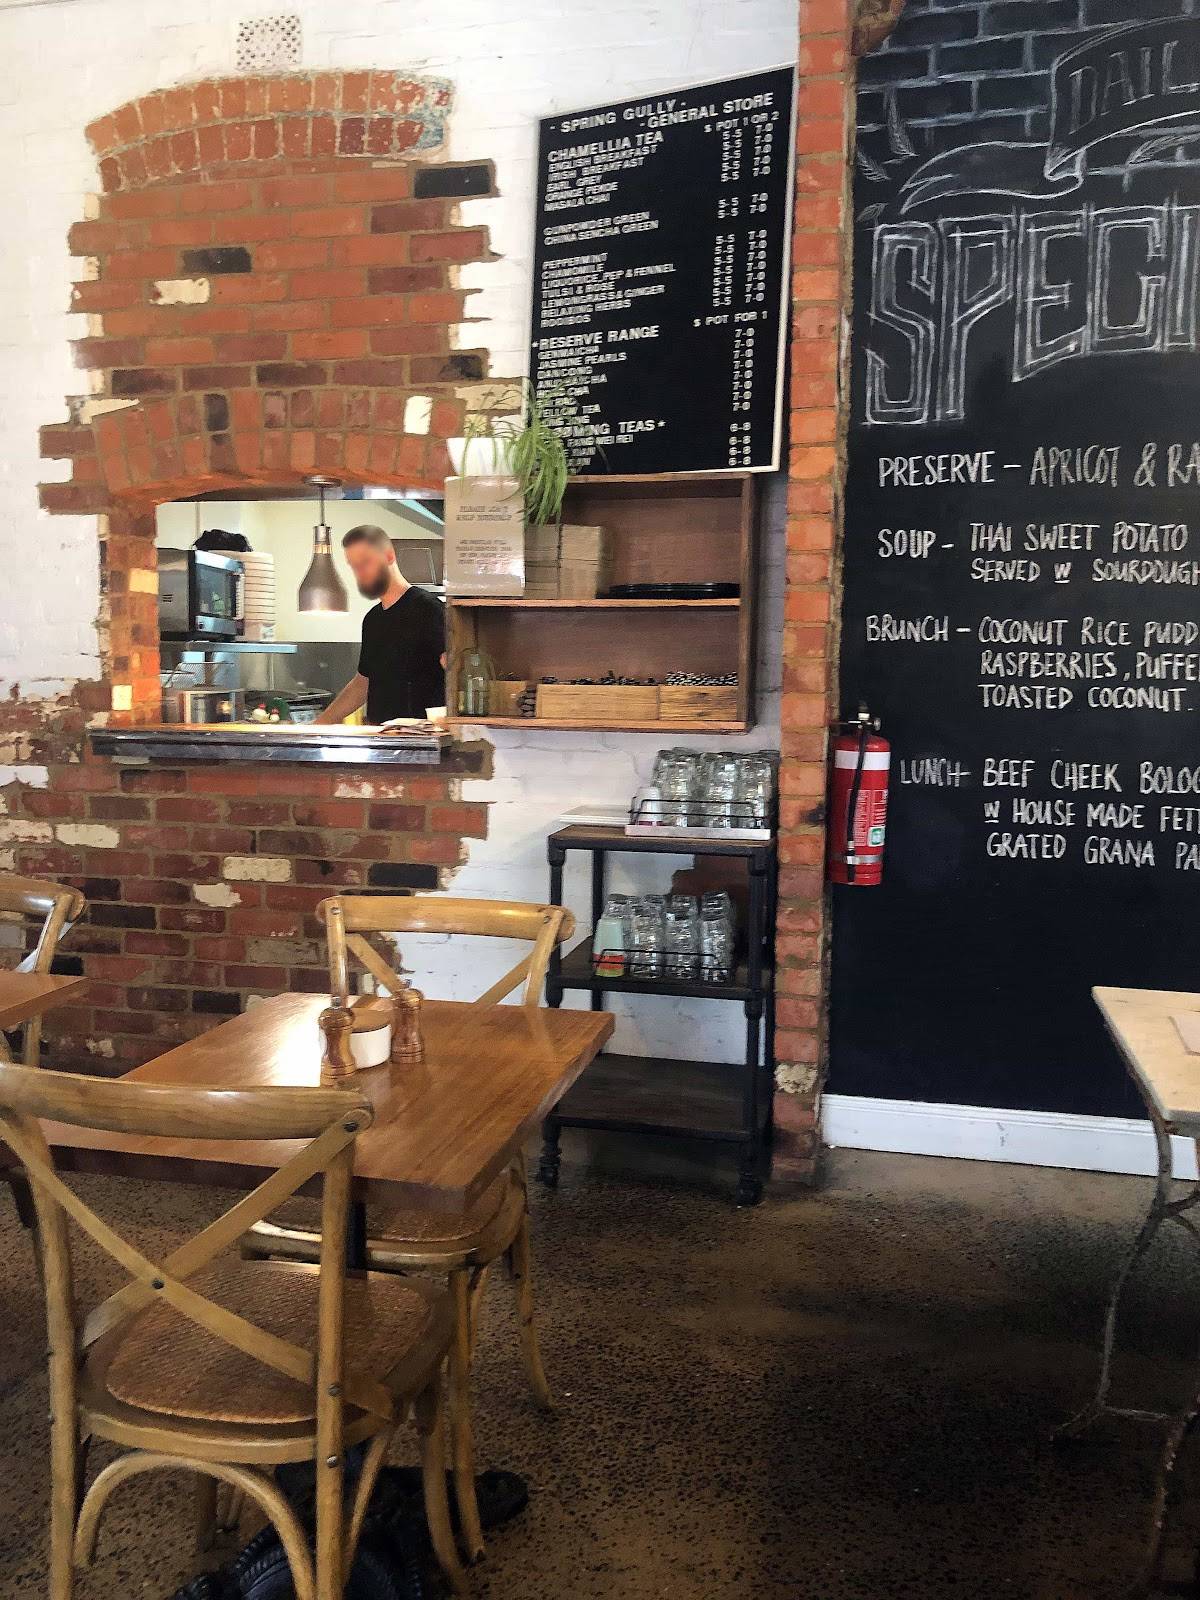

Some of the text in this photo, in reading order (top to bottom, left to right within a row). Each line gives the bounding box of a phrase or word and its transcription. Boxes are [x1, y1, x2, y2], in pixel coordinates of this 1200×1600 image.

[560, 99, 677, 133] SPRING GULLY
[723, 92, 774, 114] STORE
[716, 118, 740, 131] POT
[771, 111, 780, 120] 2
[547, 130, 664, 162] CHAMELLIA TEA
[549, 157, 592, 173] ENGLISH
[592, 144, 658, 165] BREAKFAST
[581, 157, 645, 176] BREAKFAST
[606, 325, 661, 343] RANGE
[705, 315, 730, 326] POT
[878, 450, 996, 488] PRESERVE
[1028, 444, 1122, 488] APRICOT
[1133, 442, 1157, 487] &
[877, 528, 937, 559] SOUP
[970, 521, 1013, 552] THAI
[1023, 522, 1101, 552] SWEET
[1112, 521, 1189, 553] POTATO
[970, 557, 1041, 583] SERVED
[865, 613, 949, 642] BRUNCH
[978, 616, 1069, 645] COCONUT
[1080, 616, 1132, 646] RICE
[1135, 651, 1200, 682] PUFFE
[978, 684, 1074, 710] TOASTED
[982, 757, 1036, 788] BEEF
[1050, 759, 1122, 792] CHEEK
[1012, 797, 1076, 827] HOUSE
[1086, 801, 1145, 829] MADE
[986, 831, 1200, 870] GRATED GRANA PA
